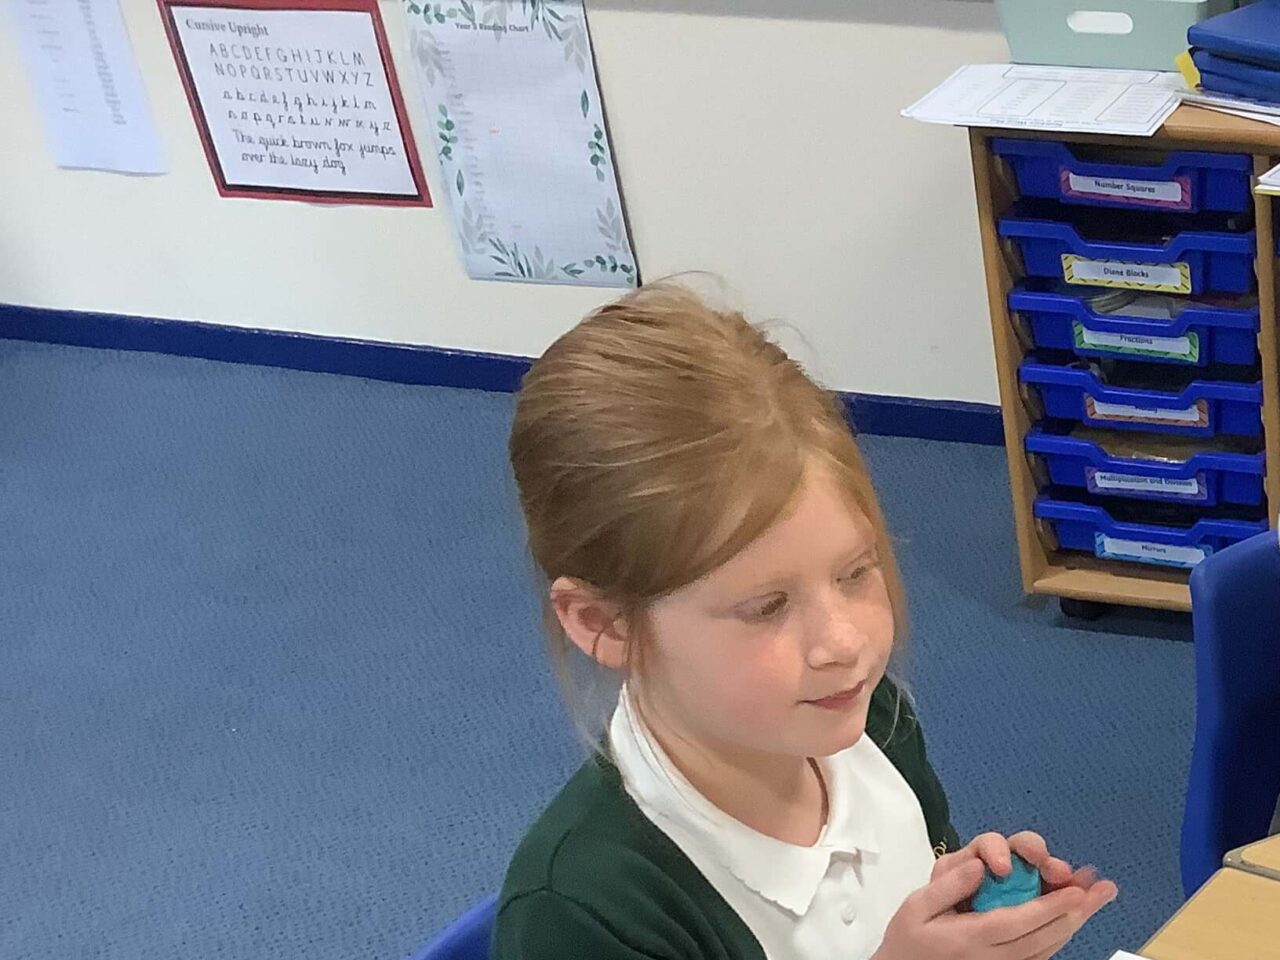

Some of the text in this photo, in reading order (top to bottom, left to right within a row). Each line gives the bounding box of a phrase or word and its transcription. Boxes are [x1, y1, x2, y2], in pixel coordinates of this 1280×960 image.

[186, 18, 270, 37] Cursive Upright
[479, 23, 507, 34] Reading
[509, 24, 529, 32] Chart
[232, 128, 253, 145] The
[292, 136, 332, 151] brown
[333, 138, 354, 158] fox
[358, 141, 397, 160] jumps
[241, 153, 347, 176] over the lazy dog
[1094, 180, 1156, 193] Number Squares
[1126, 269, 1149, 278] Blocks
